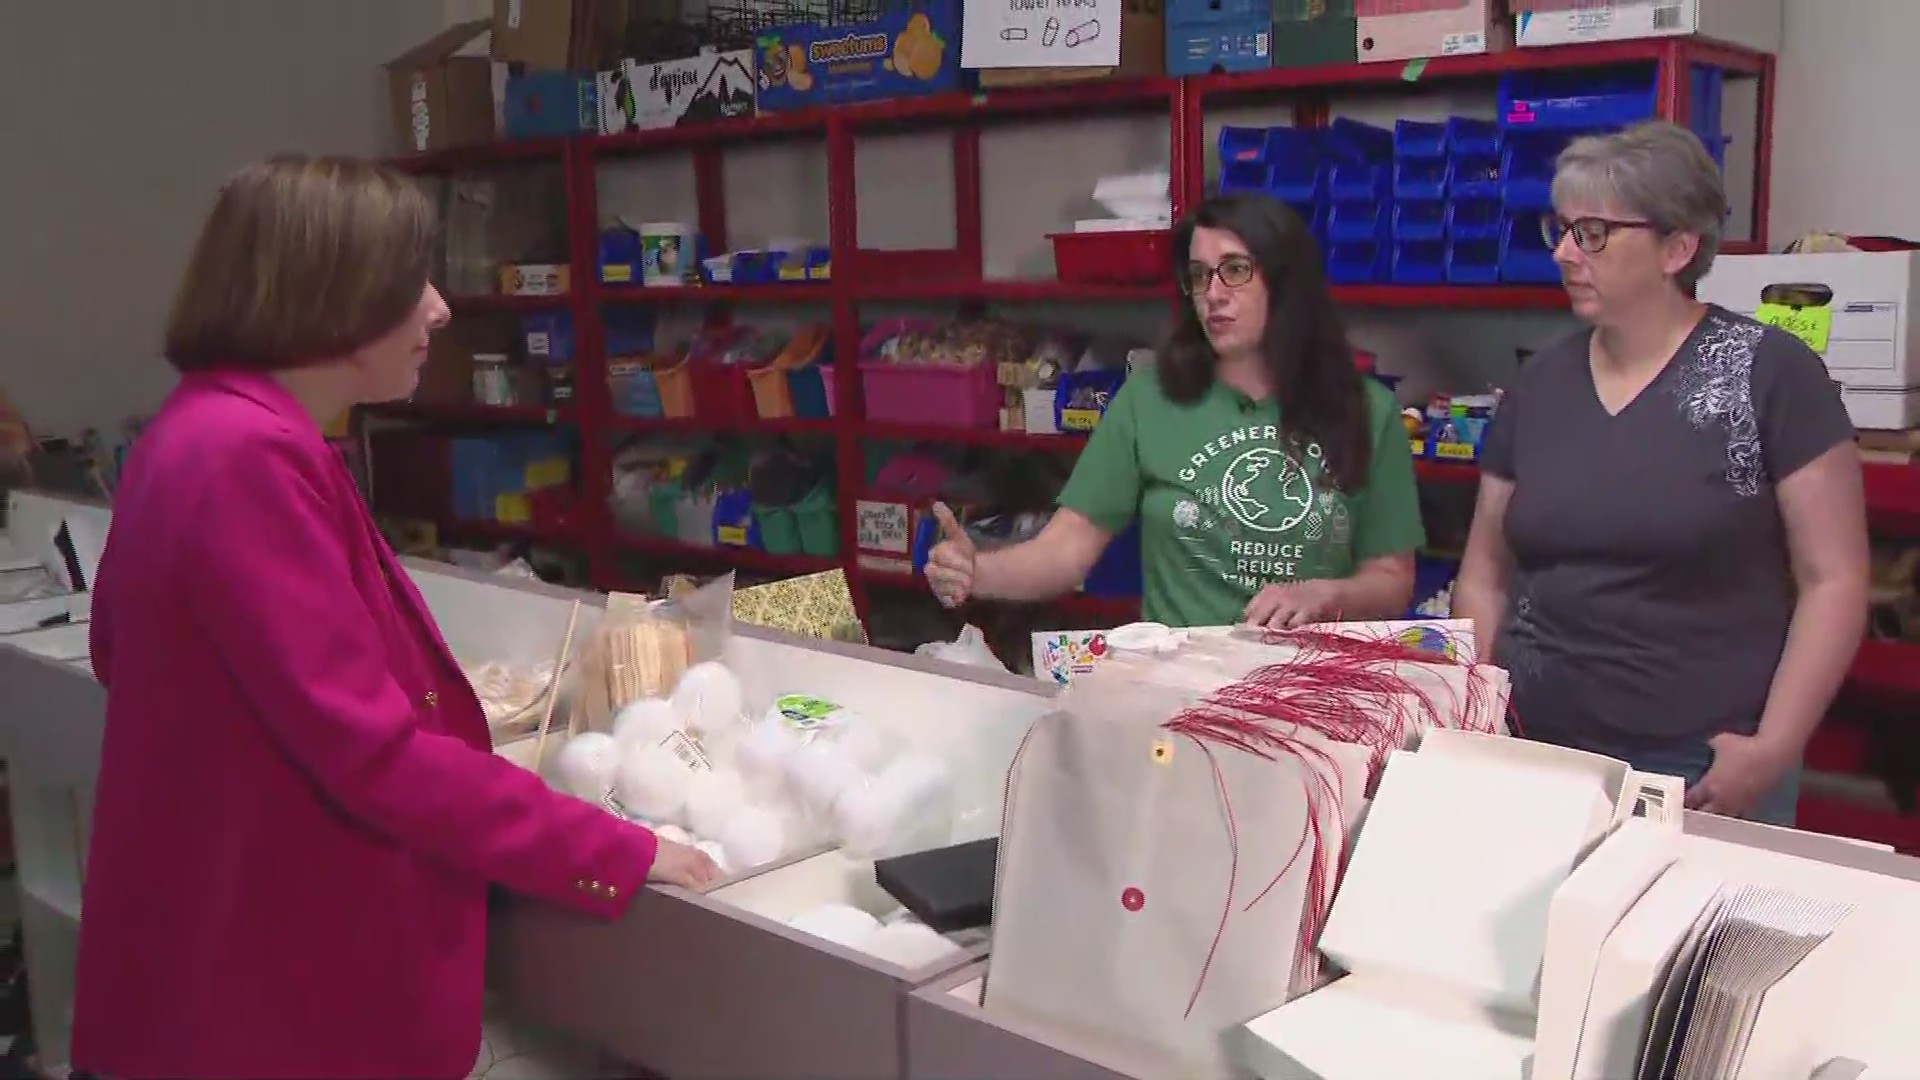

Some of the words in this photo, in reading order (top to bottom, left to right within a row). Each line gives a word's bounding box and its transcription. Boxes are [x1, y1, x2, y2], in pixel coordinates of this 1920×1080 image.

[1179, 425, 1277, 482] GREENER
[1230, 540, 1304, 558] REDUCE
[1236, 558, 1296, 576] REUSE
